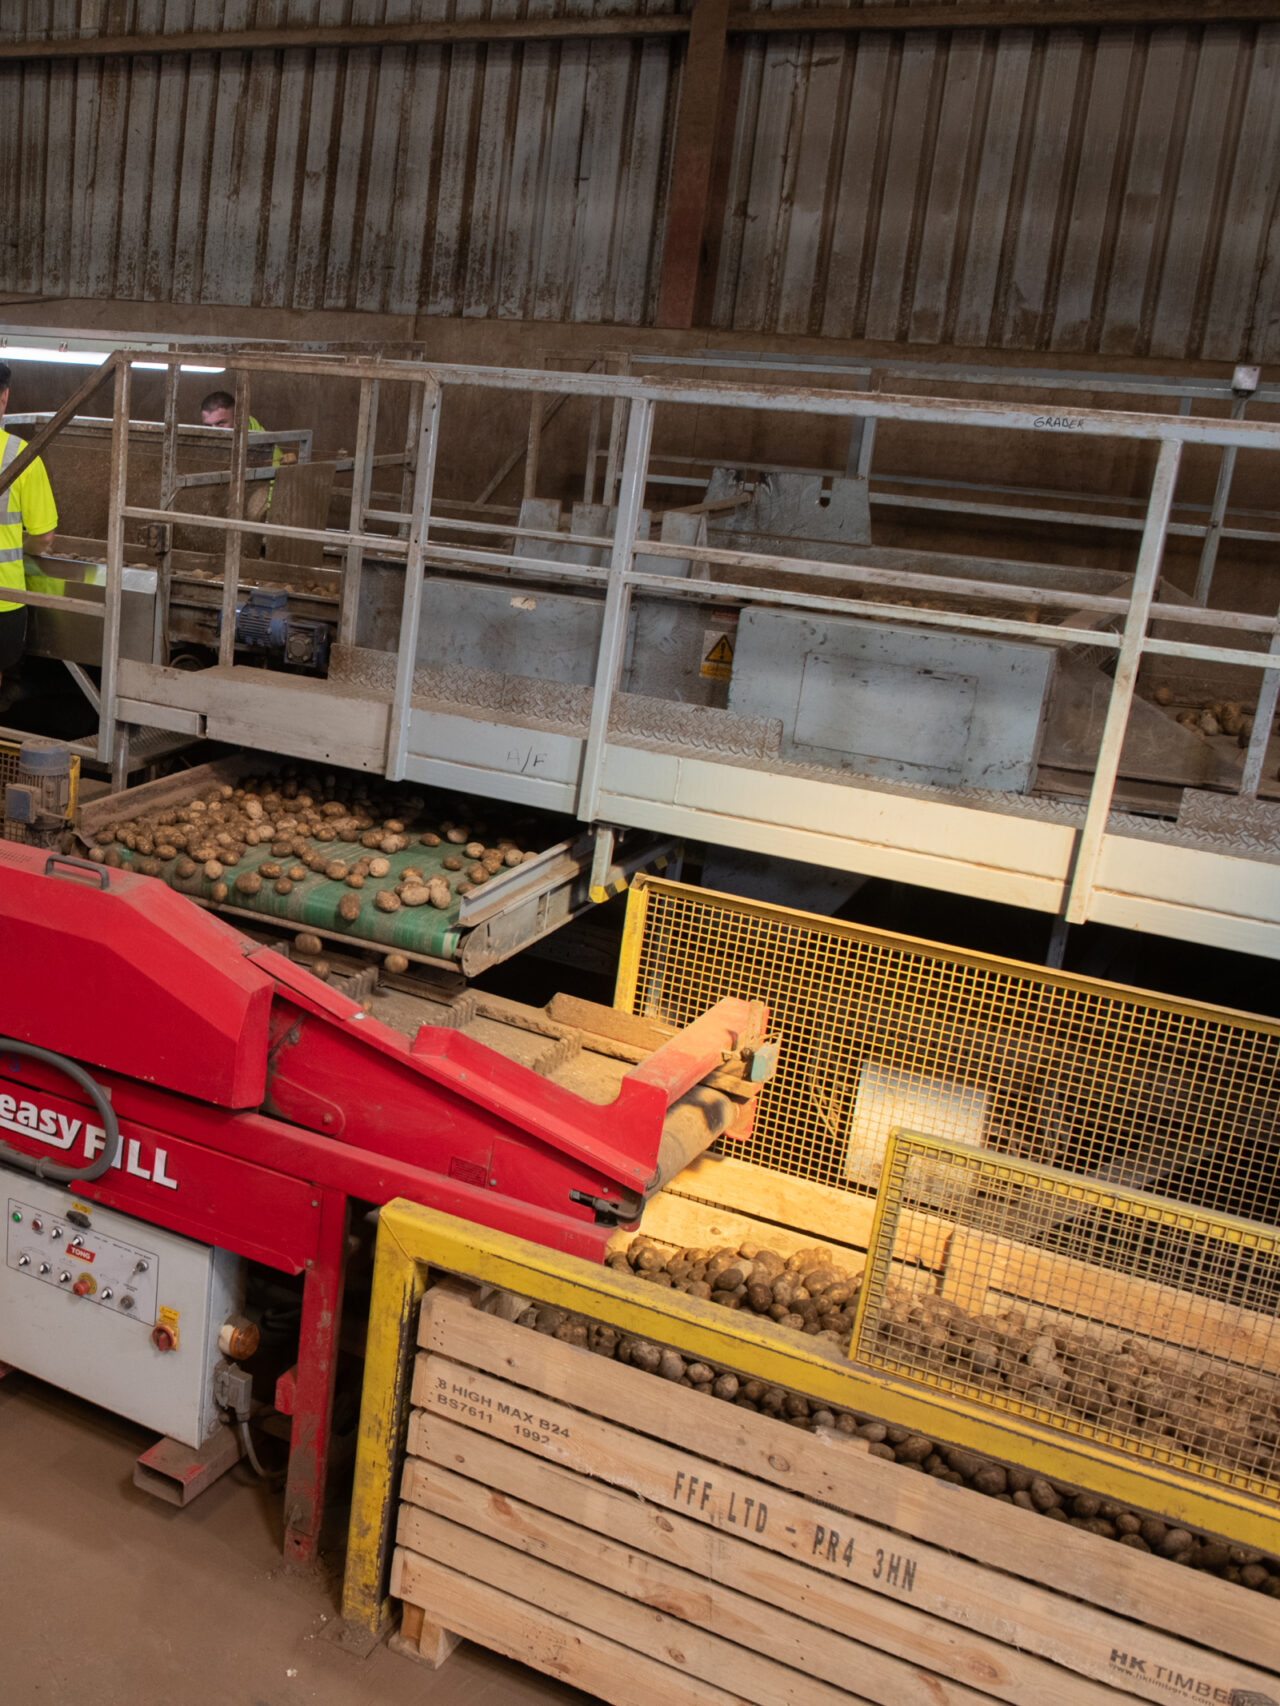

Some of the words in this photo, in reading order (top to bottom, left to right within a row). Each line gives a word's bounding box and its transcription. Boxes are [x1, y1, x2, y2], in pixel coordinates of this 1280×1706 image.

[1033, 416, 1086, 431] GRADER
[70, 1246, 91, 1260] TONG
[437, 1393, 493, 1423] BS7611
[439, 1379, 447, 1390] 8
[452, 1384, 492, 1408] HIGH
[497, 1402, 534, 1424] MAX
[539, 1418, 570, 1438] B24
[673, 1471, 713, 1511] FFF
[727, 1491, 768, 1533] LTD
[812, 1525, 855, 1568] PR4
[873, 1548, 917, 1592] 3HN
[1109, 1648, 1147, 1674] HK
